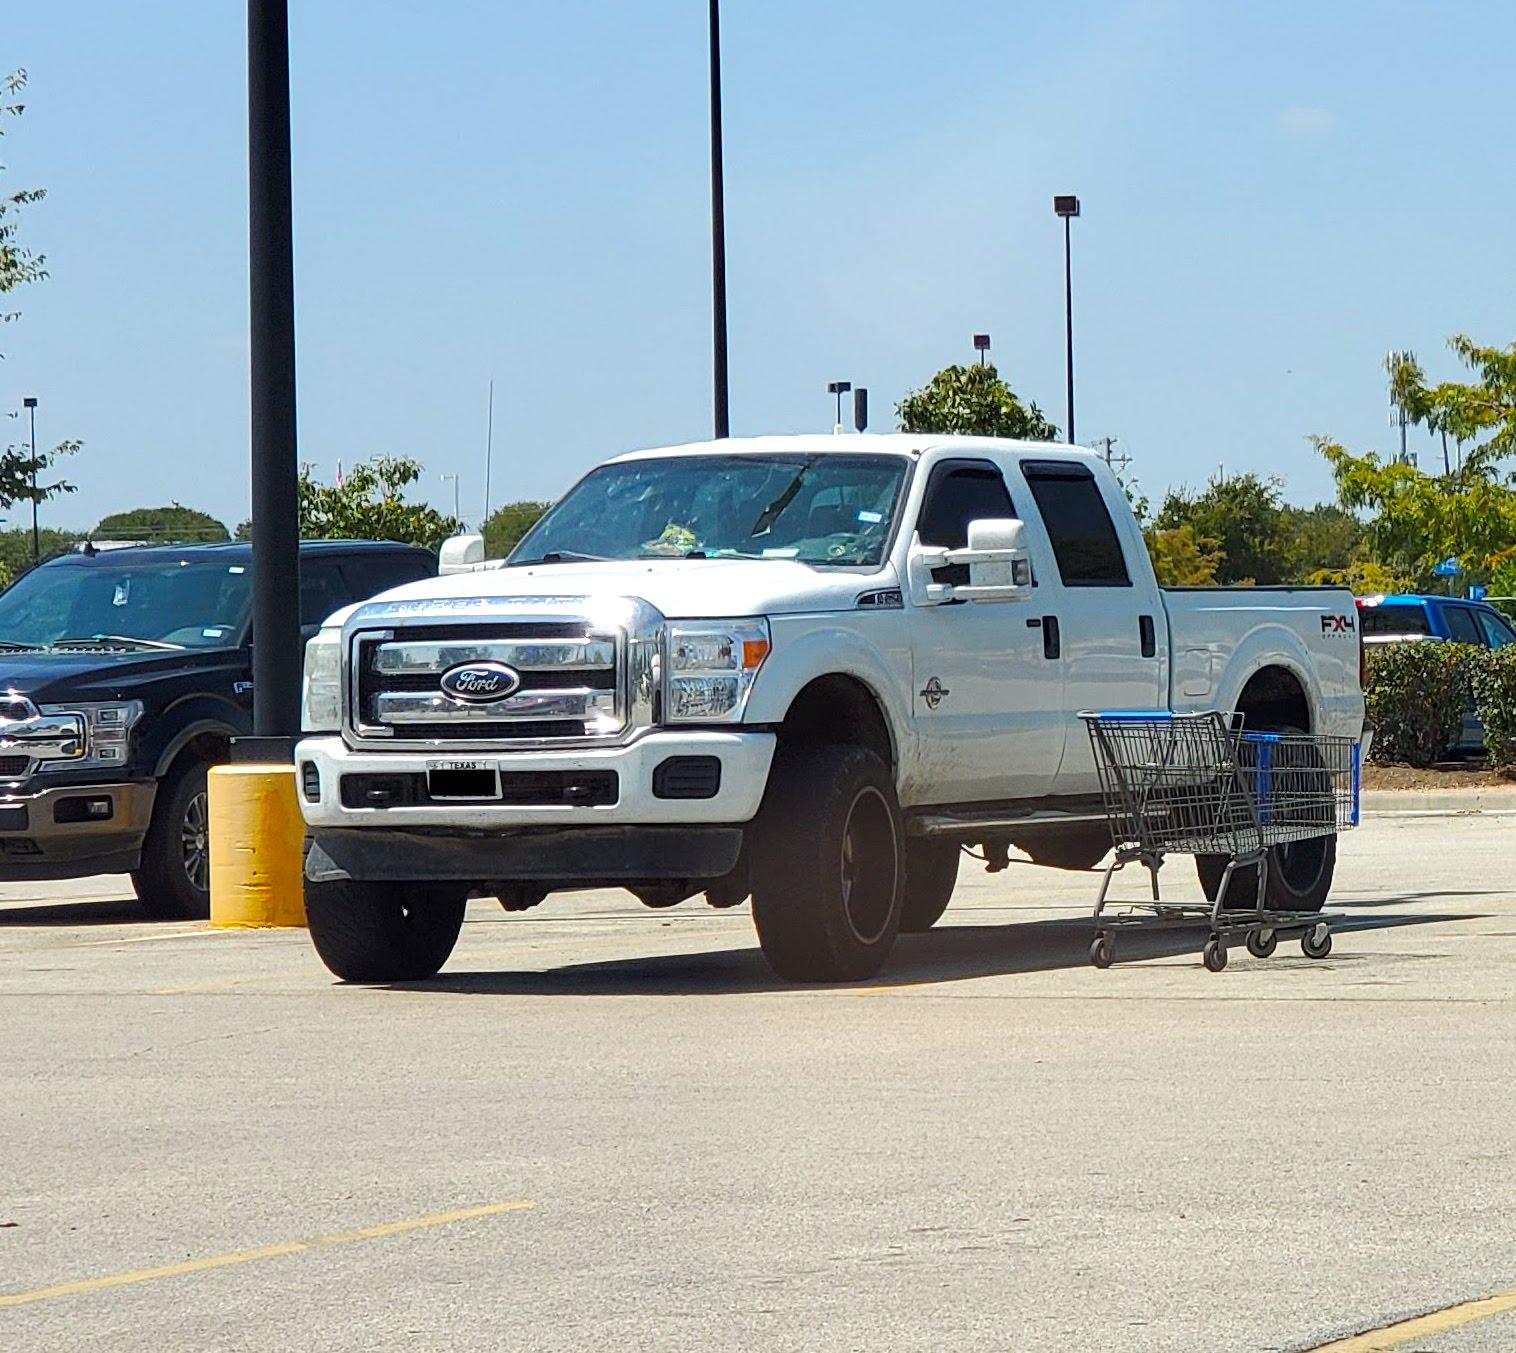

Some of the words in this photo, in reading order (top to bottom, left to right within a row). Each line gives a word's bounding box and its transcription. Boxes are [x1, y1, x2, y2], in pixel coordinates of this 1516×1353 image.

[1320, 615, 1356, 632] FX4
[456, 670, 499, 691] Ford
[449, 761, 477, 770] TEXAS
